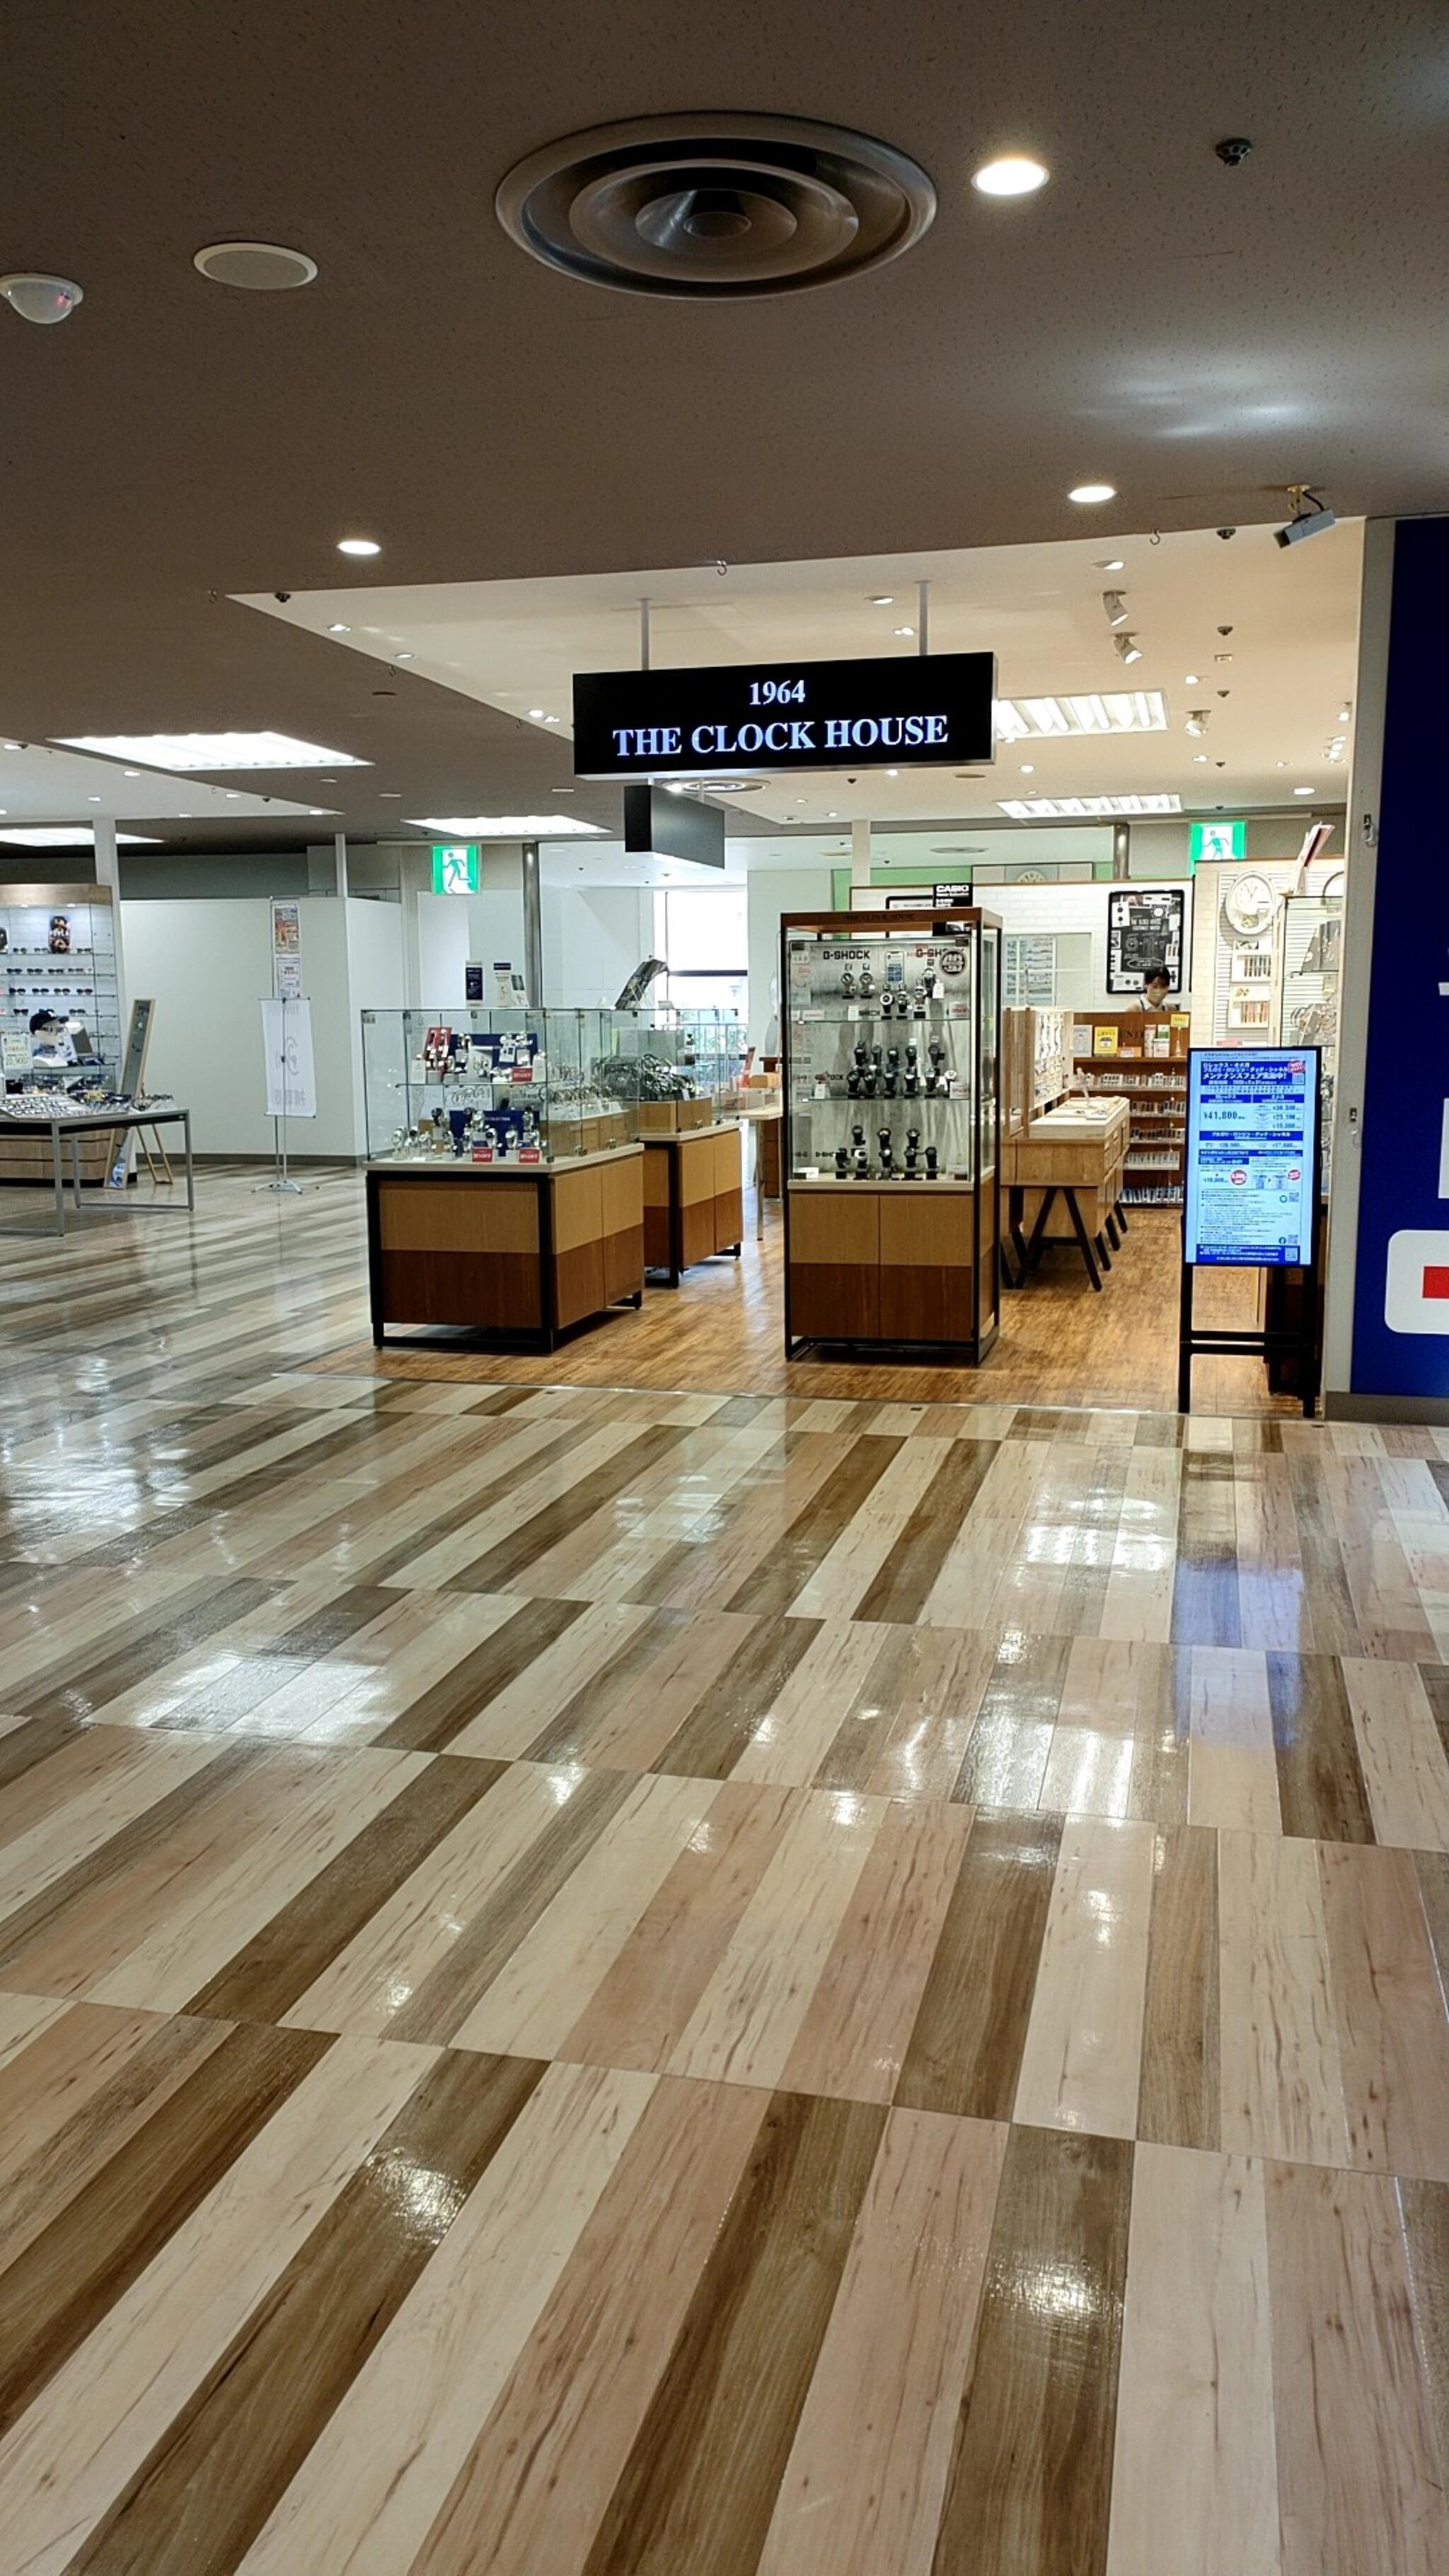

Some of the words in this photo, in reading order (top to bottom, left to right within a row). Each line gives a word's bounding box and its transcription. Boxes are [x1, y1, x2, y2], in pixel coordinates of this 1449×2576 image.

[749, 679, 805, 705] 1964
[613, 727, 681, 756] THE
[691, 720, 816, 752] CLOCK
[824, 715, 949, 748] HOUSE
[823, 950, 870, 960] G-SHOCK
